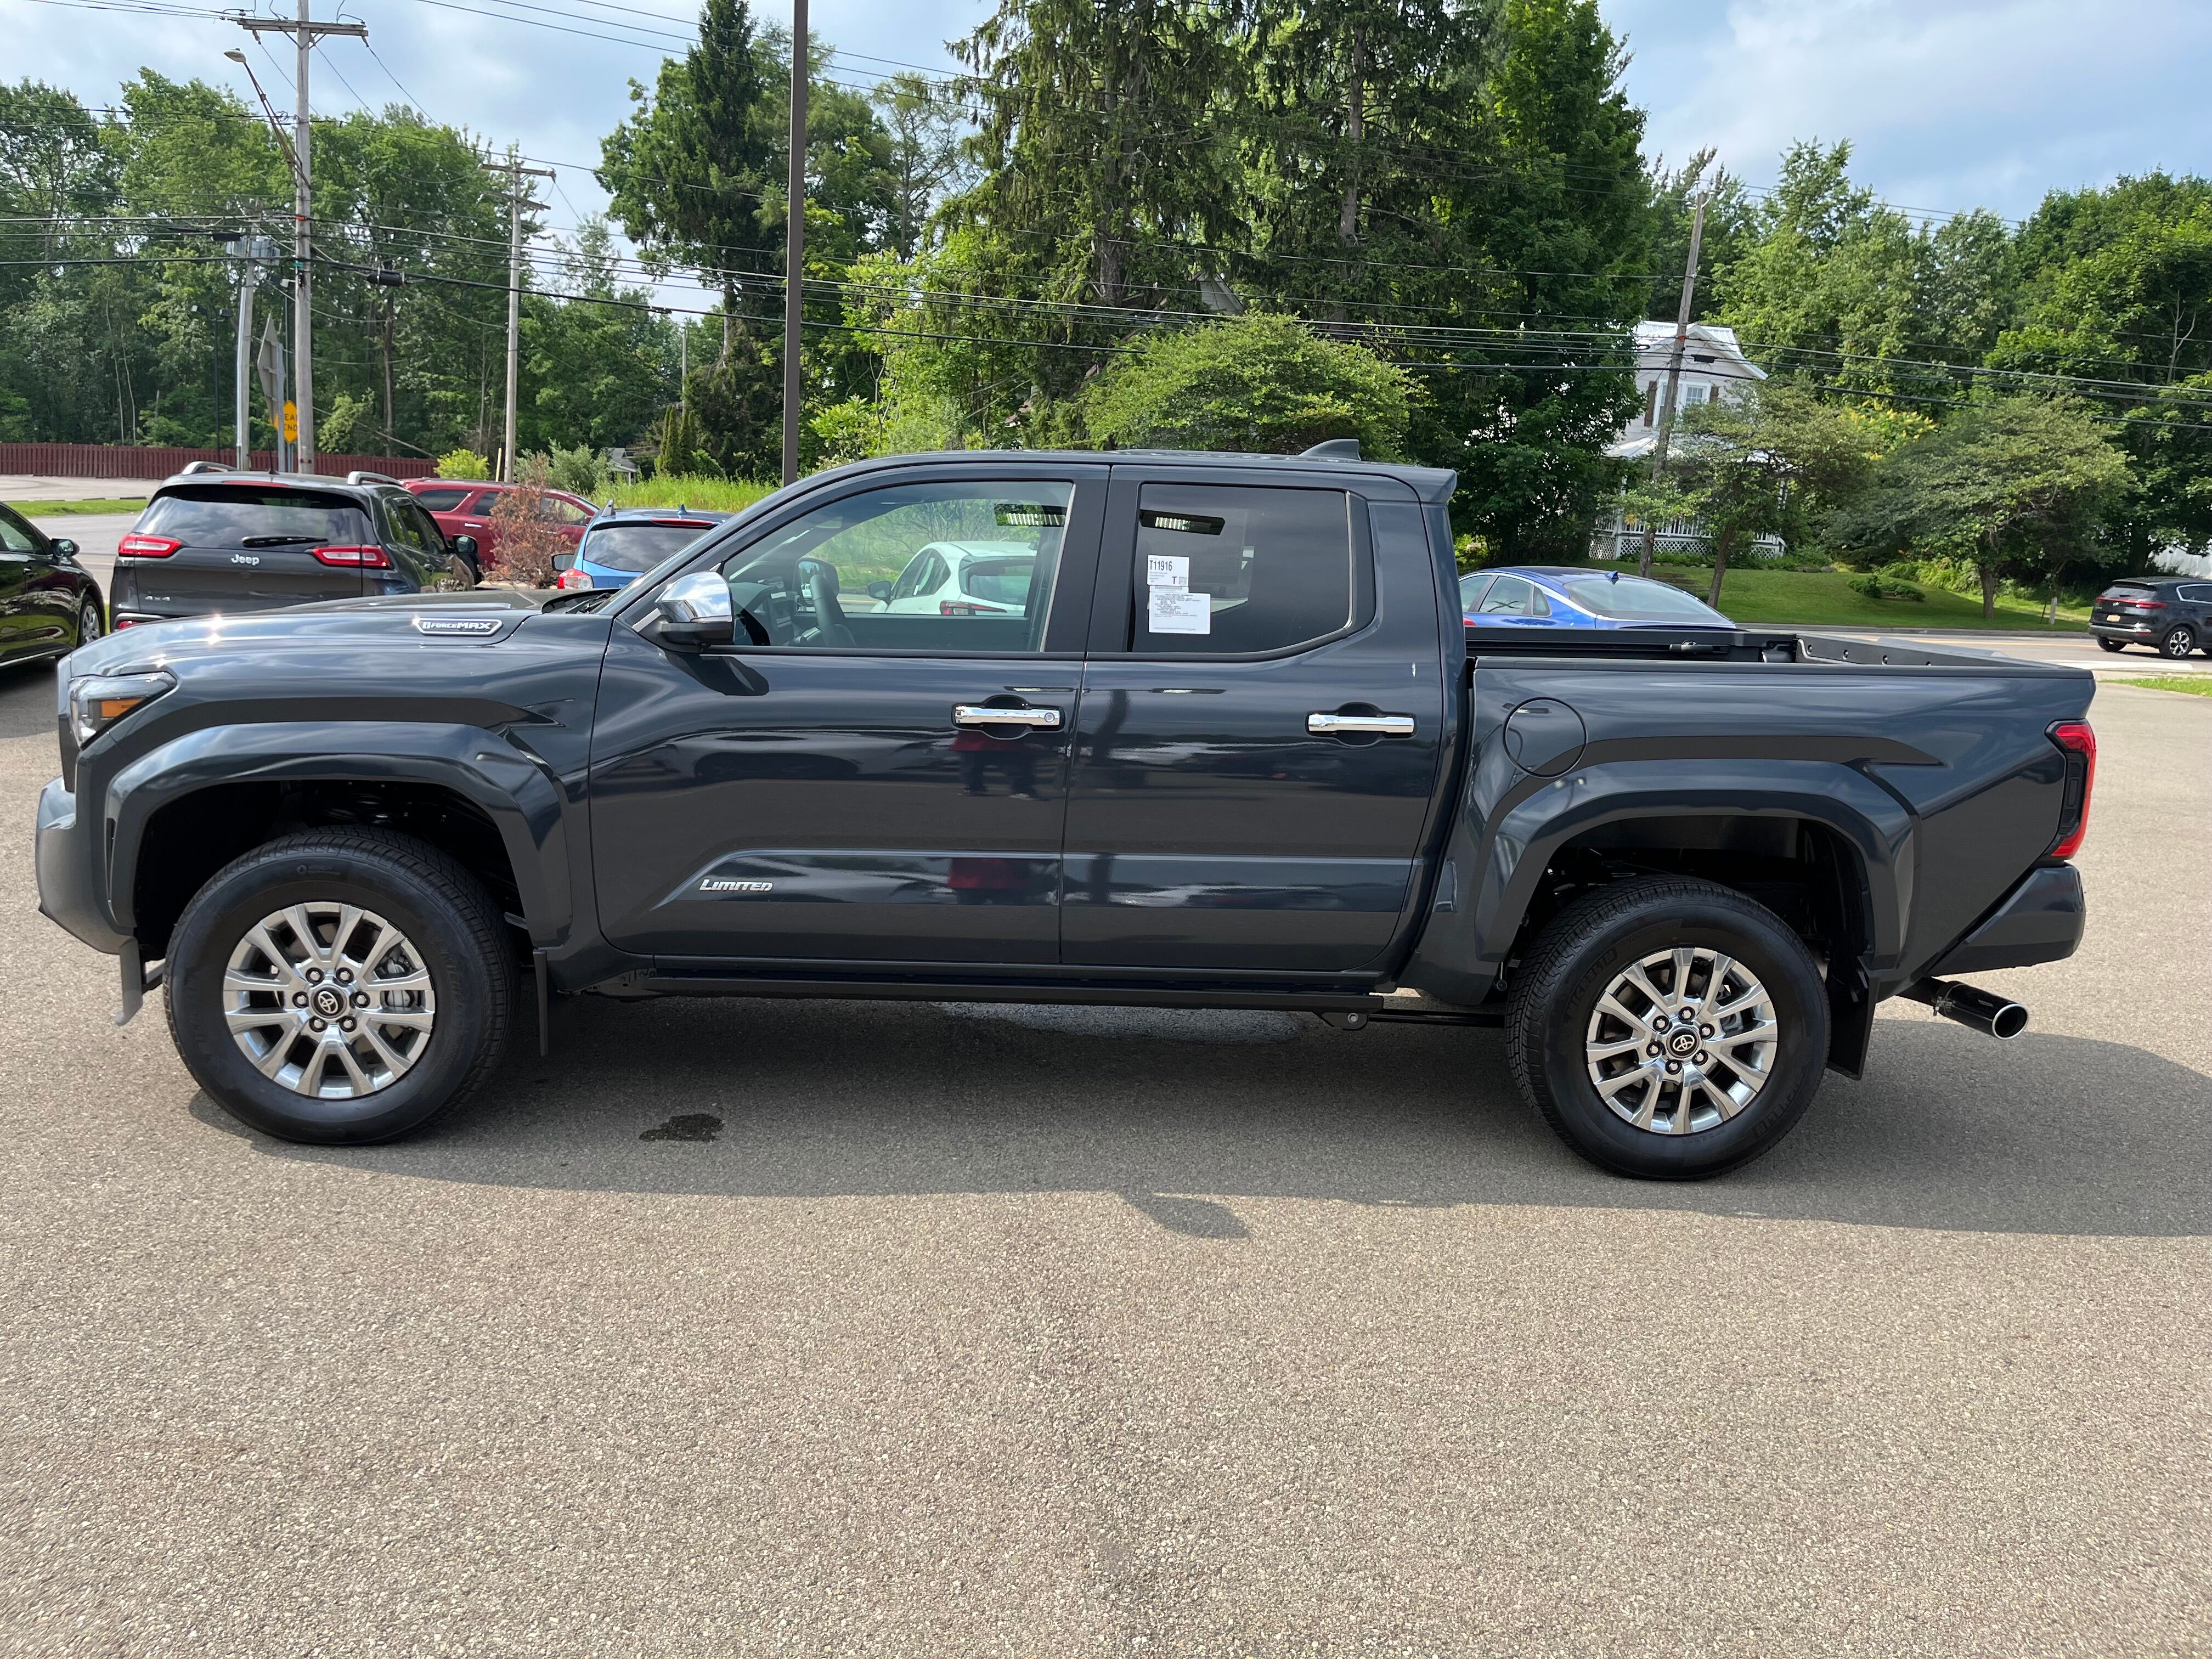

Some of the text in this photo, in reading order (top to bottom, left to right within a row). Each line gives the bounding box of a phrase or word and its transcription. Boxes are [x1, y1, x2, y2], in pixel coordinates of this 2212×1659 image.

[284, 413, 298, 421] EA
[231, 554, 260, 566] Jeep
[1149, 560, 1172, 571] T11916
[1172, 576, 1177, 584] T
[699, 879, 774, 891] LIMITED
